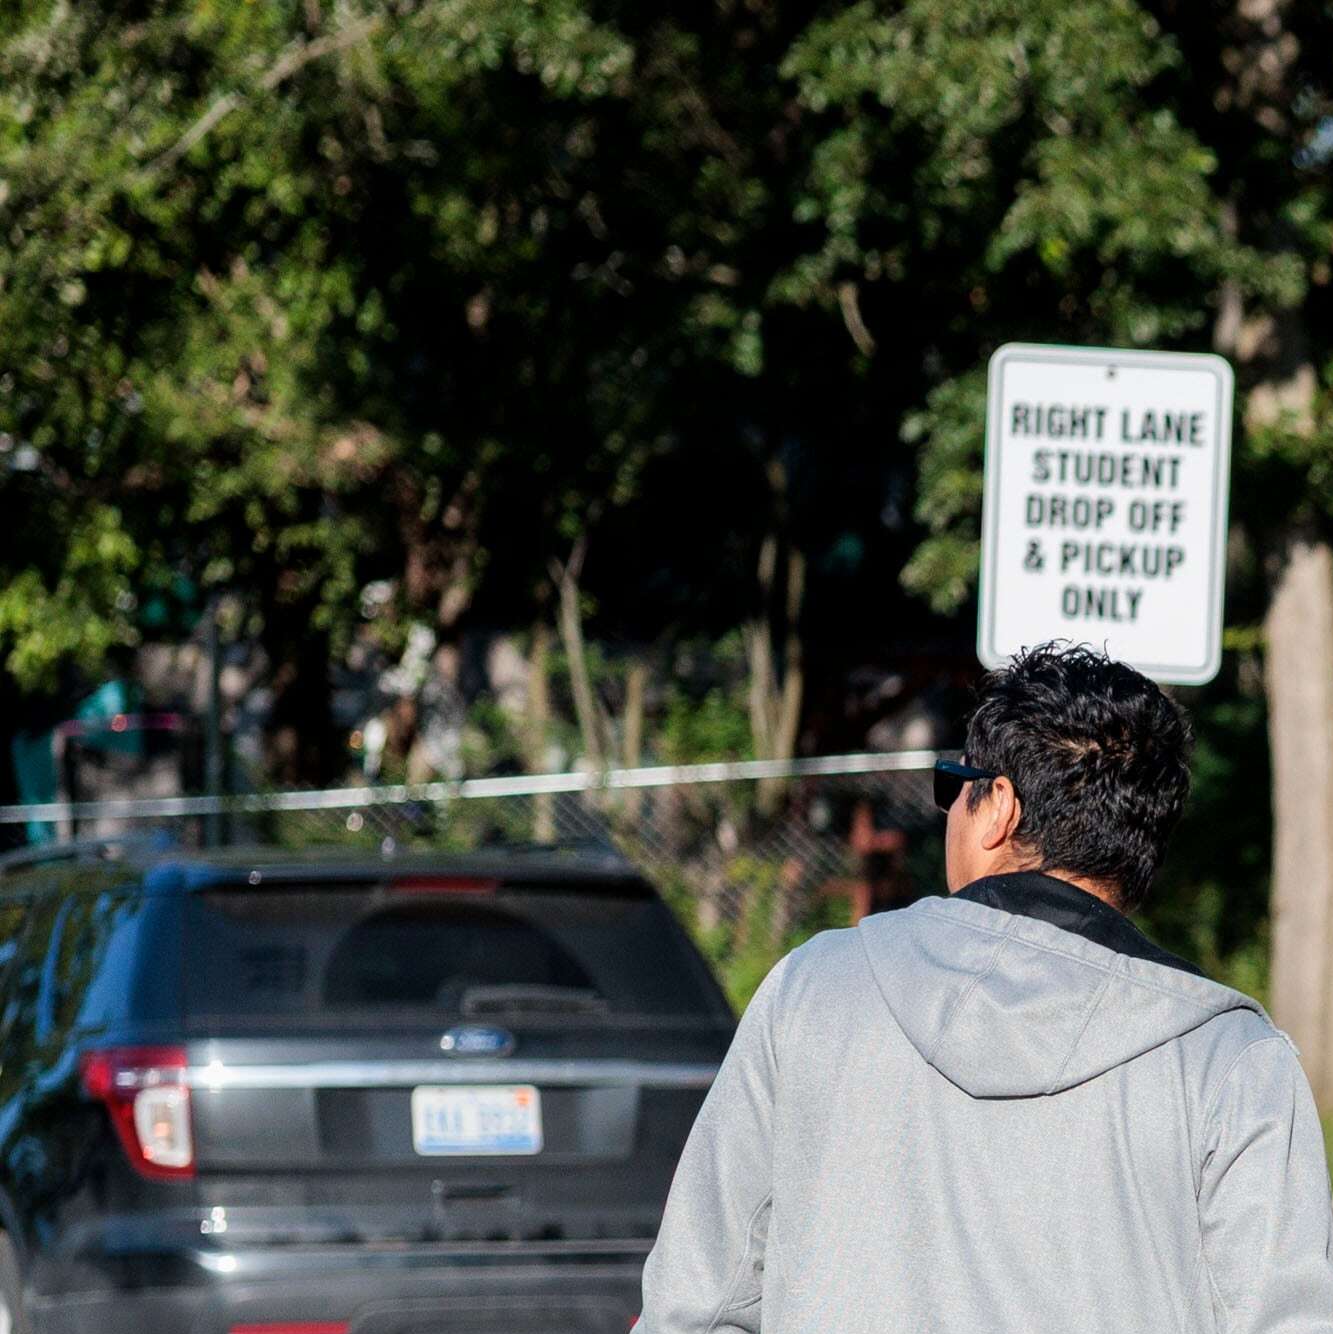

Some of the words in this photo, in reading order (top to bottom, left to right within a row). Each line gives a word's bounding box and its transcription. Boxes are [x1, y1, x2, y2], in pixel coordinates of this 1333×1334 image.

[1011, 404, 1107, 439] RIGHT
[1120, 409, 1205, 447] LANE
[1033, 450, 1181, 488] STUDENT
[1025, 494, 1115, 529] DROP
[1128, 501, 1183, 533] OFF
[1023, 540, 1045, 572] &
[1060, 541, 1185, 578] PICKUP
[1061, 586, 1143, 621] ONLY
